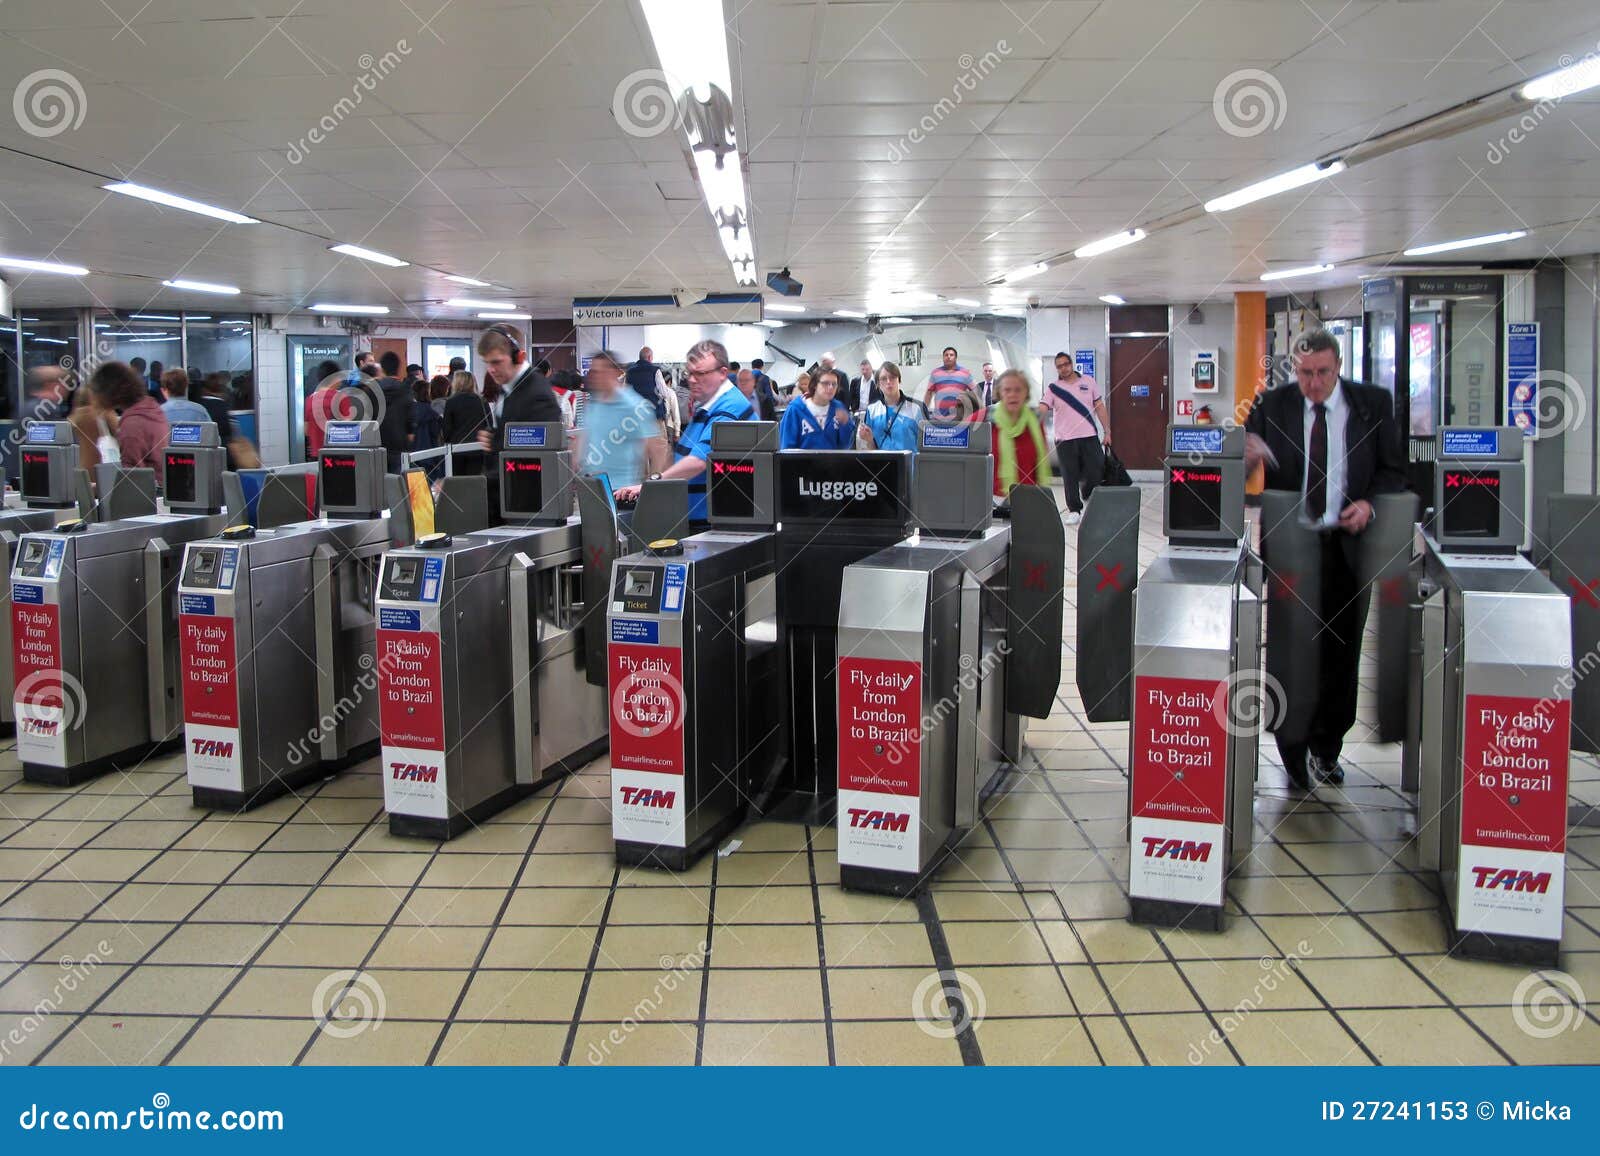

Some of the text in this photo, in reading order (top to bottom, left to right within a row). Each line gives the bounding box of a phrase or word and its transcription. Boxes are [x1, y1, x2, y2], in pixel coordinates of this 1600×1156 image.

[586, 308, 644, 319] Victoria line
[1511, 325, 1529, 333] Zone
[1187, 472, 1221, 483] No entry
[798, 476, 878, 500] Luggage
[627, 600, 648, 609] Ticket
[18, 611, 52, 627] Fly daily
[25, 626, 46, 638] from
[187, 624, 227, 642] Fly daily
[20, 639, 52, 652] London
[196, 639, 219, 654] from
[386, 640, 431, 658] Fly daily
[20, 654, 54, 666] to Brazil
[190, 655, 226, 669] London
[396, 656, 422, 671] from
[618, 656, 671, 675] Fly daily
[190, 670, 229, 684] to Brazil
[389, 672, 430, 688] London
[630, 673, 661, 688] from
[850, 669, 909, 691] Fly daily
[388, 690, 433, 704] to Brazil
[622, 690, 669, 707] London
[862, 689, 896, 705] from
[1148, 689, 1215, 712] Fly daily
[621, 708, 672, 724] to Brazil
[853, 707, 906, 724] London
[1161, 709, 1200, 727] from
[1480, 708, 1556, 733] Fly daily
[22, 717, 59, 737] TAM
[850, 725, 909, 742] to Brazil
[1150, 728, 1210, 747] London
[1495, 730, 1538, 749] from
[191, 737, 234, 759] TAM
[621, 754, 673, 767] tamairlines.com
[1148, 748, 1212, 767] to Brazil
[1481, 750, 1550, 771] London
[390, 762, 438, 783] TAM
[849, 774, 908, 788] tamairlines.com
[1479, 772, 1552, 792] to Brazil
[619, 786, 676, 809] TAM
[1145, 800, 1211, 815] tamairlines.com
[847, 808, 910, 833] TAM
[1476, 827, 1551, 843] tamairlines.com
[1141, 836, 1213, 863] TAM
[1471, 866, 1553, 894] TAM
